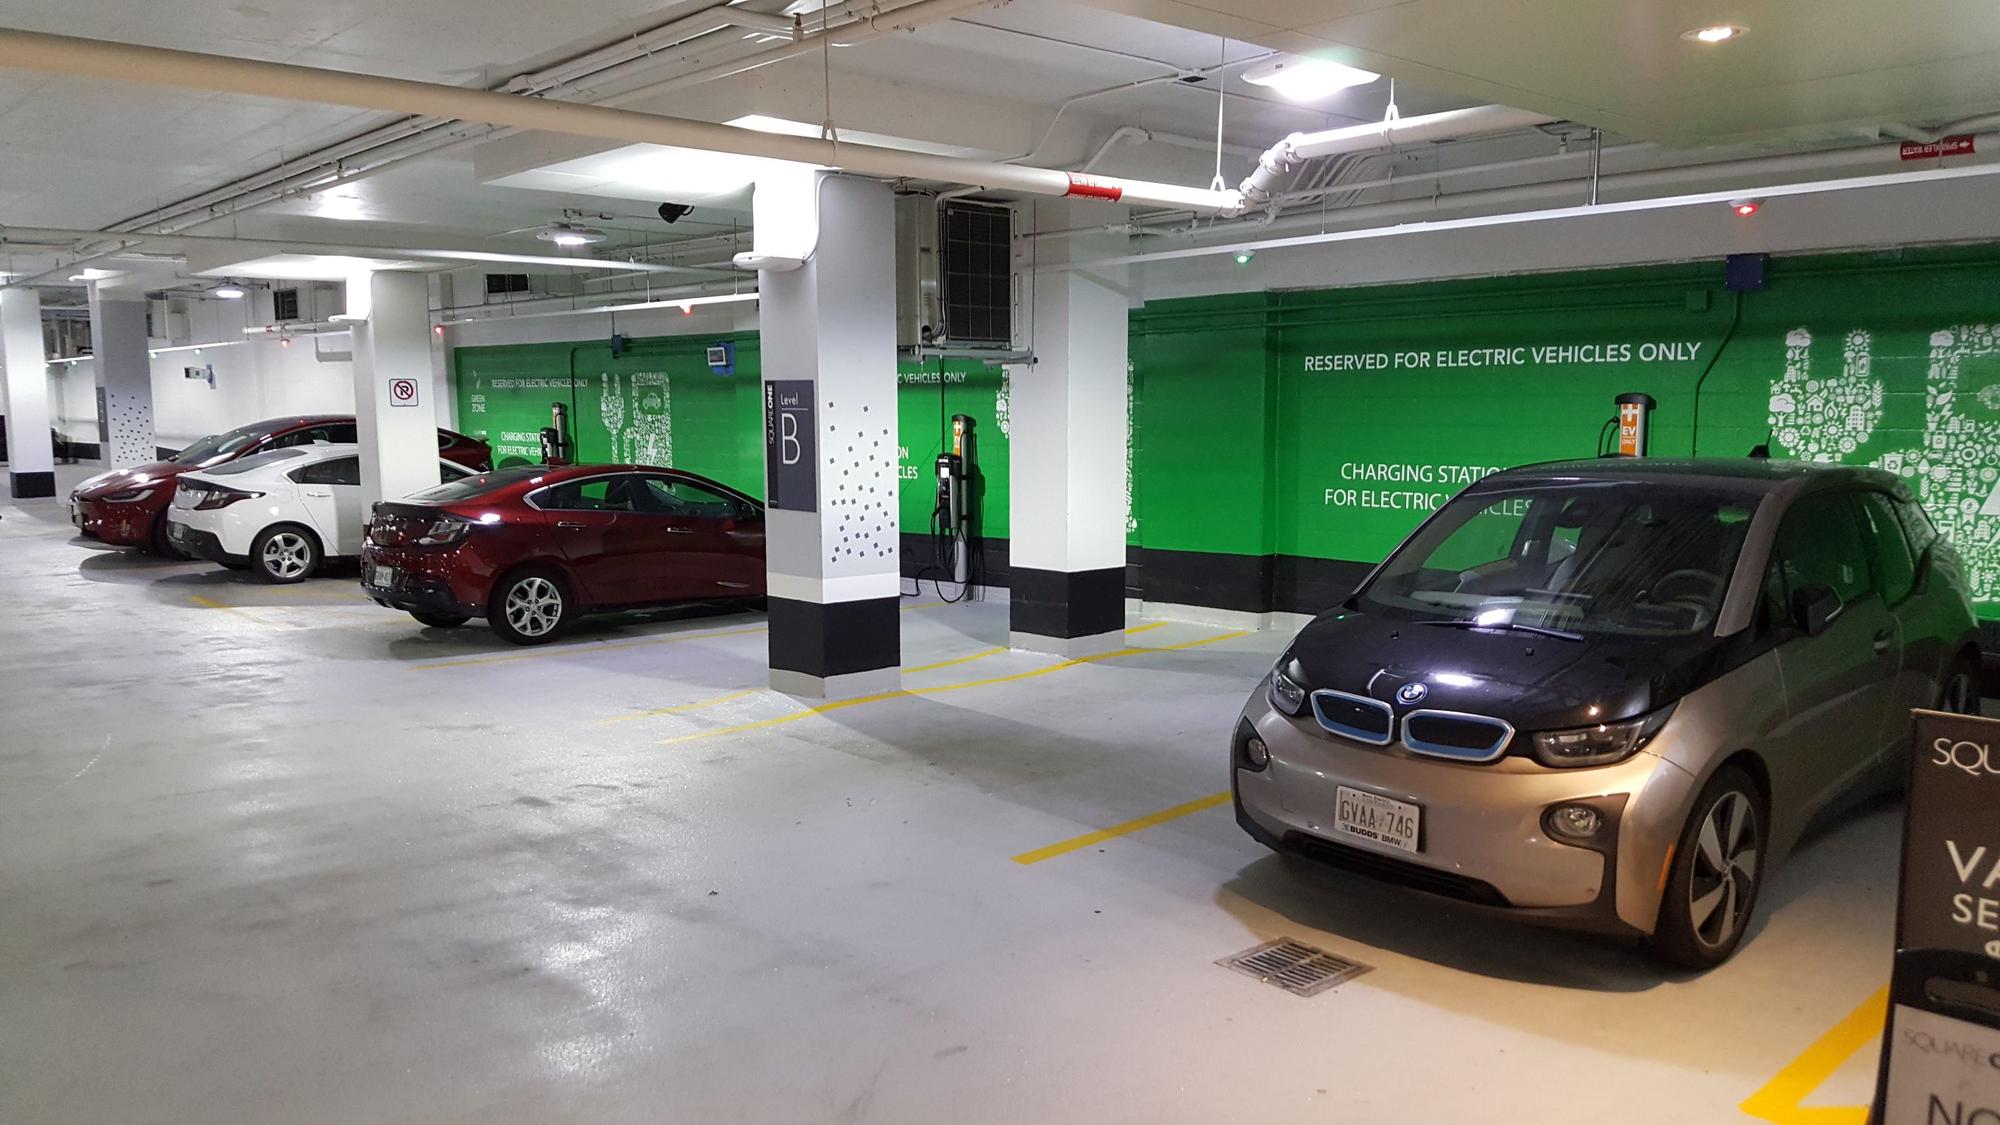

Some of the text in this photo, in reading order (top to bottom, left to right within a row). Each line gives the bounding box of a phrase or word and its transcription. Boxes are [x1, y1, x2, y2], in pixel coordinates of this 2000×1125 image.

[1304, 342, 1701, 371] RESERVED FOR ELECTRIC VEHICLES ONLY
[904, 372, 940, 384] VEHICLES
[944, 371, 966, 383] ONLY
[471, 403, 486, 413] ZONE
[780, 392, 799, 406] Level
[781, 412, 801, 465] B
[1622, 426, 1637, 436] EV
[1340, 462, 1507, 484] CHARGING STATI
[1325, 489, 1357, 507] FOR
[1361, 491, 1442, 511] ELECTRIC
[1386, 811, 1414, 839] 746
[1381, 834, 1402, 847] BMW
